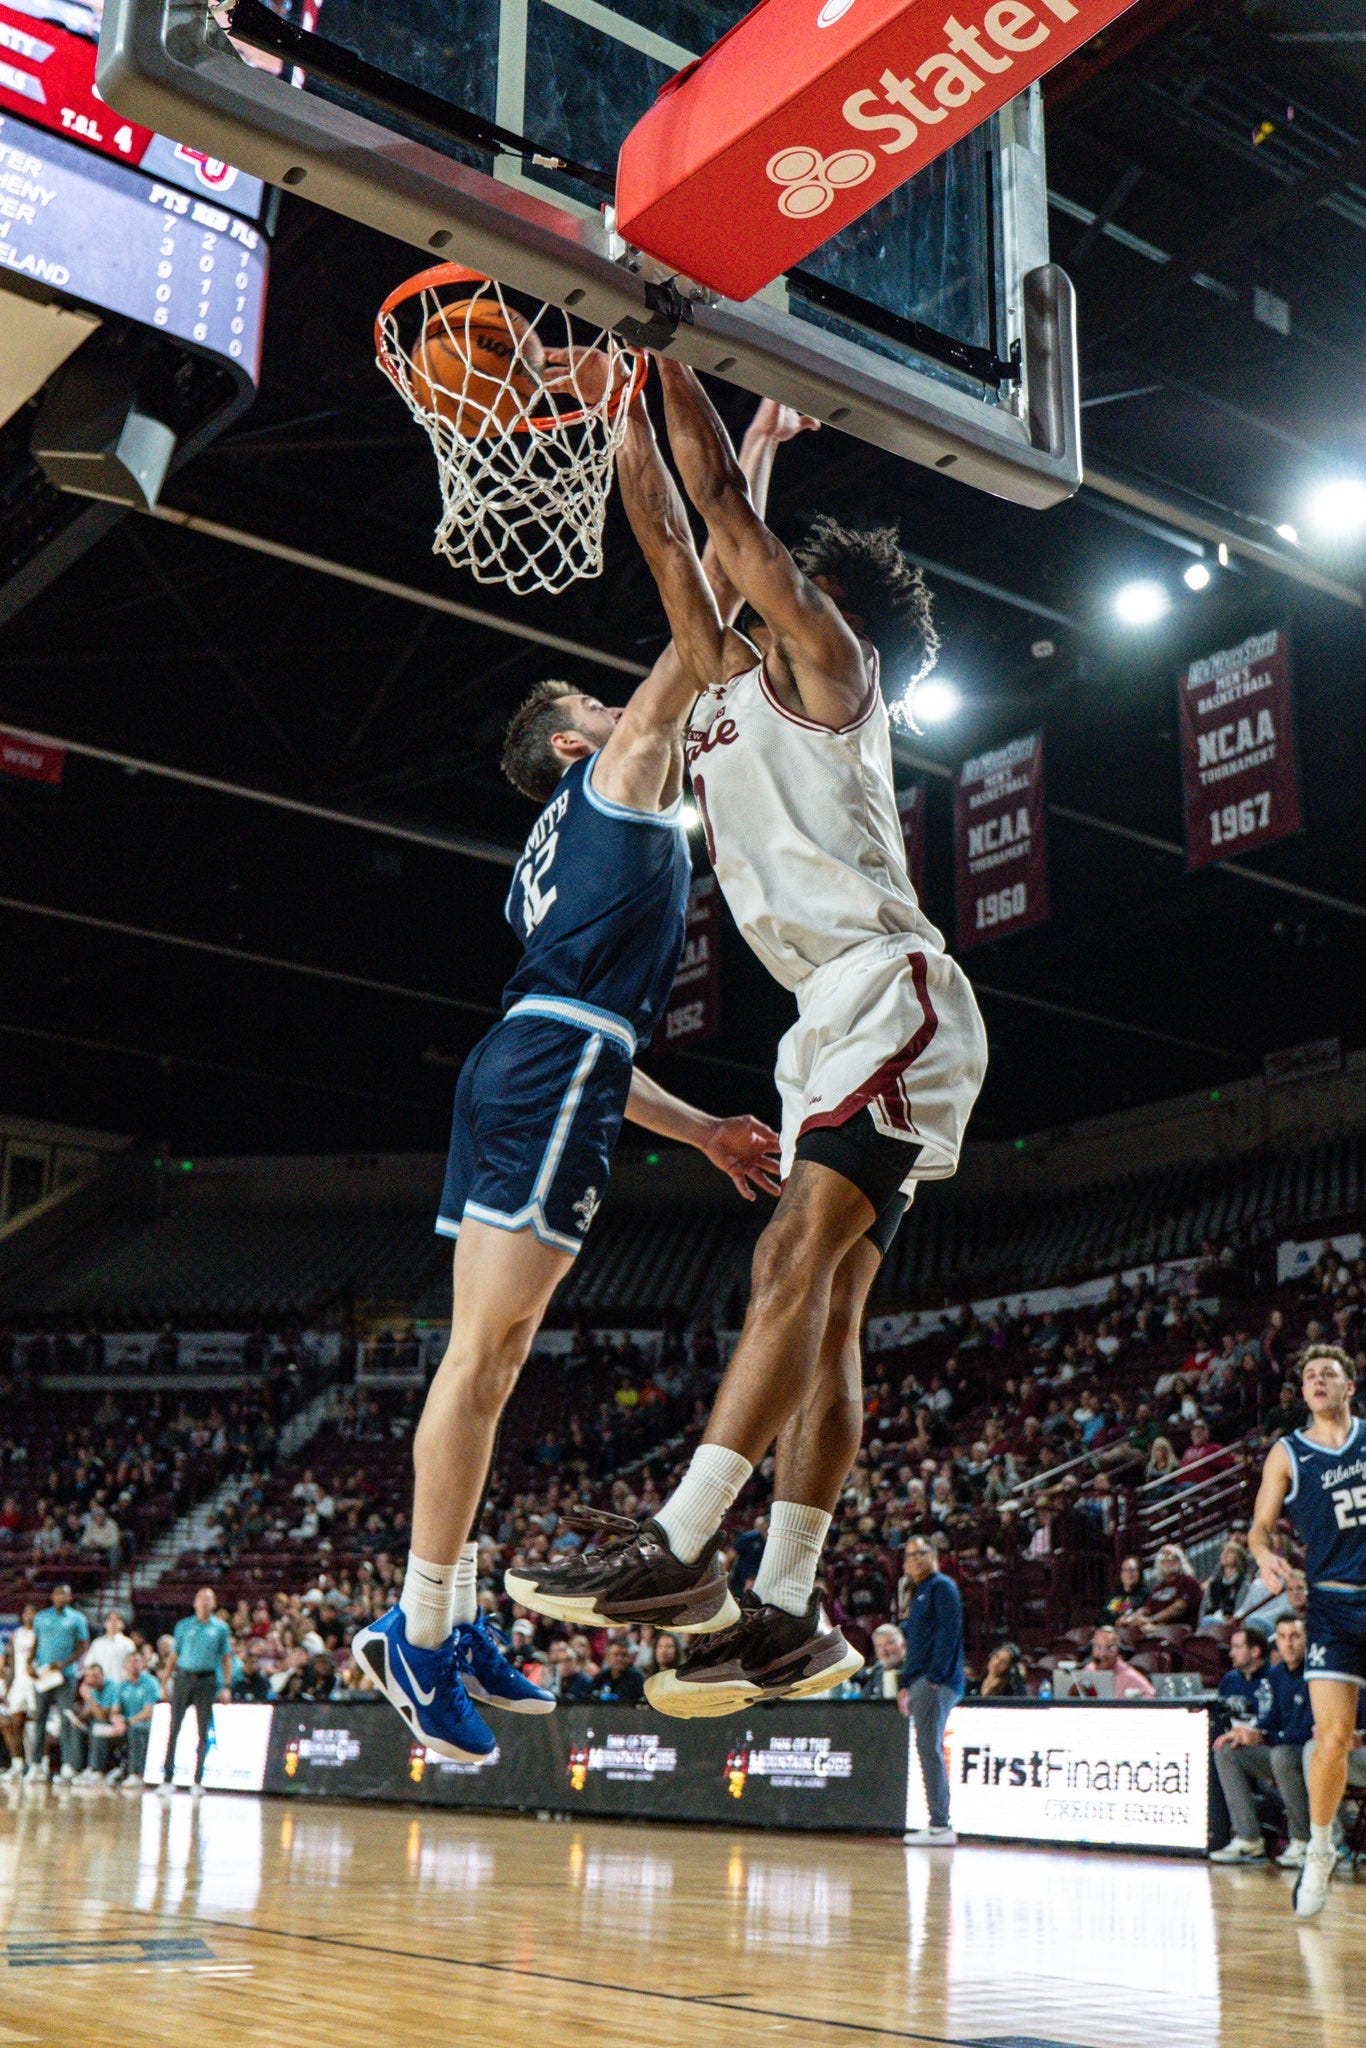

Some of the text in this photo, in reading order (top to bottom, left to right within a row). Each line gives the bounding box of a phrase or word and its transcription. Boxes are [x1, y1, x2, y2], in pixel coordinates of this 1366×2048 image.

[842, 0, 1050, 154] State
[114, 125, 133, 154] 4
[160, 237, 175, 257] 3
[200, 254, 215, 273] 0
[236, 271, 249, 290] 0
[163, 215, 177, 233] 7
[202, 232, 217, 251] 2
[241, 252, 250, 268] 1
[156, 283, 171, 303] 0
[199, 301, 210, 318] 1
[231, 316, 244, 334] 0
[202, 278, 213, 296] 1
[236, 296, 247, 313] 1
[229, 339, 242, 358] 0
[1197, 708, 1275, 768] NCAA
[521, 788, 570, 862] MITH
[968, 807, 1031, 857] NCAA
[1209, 791, 1271, 846] 1967
[975, 882, 1026, 929] 1960
